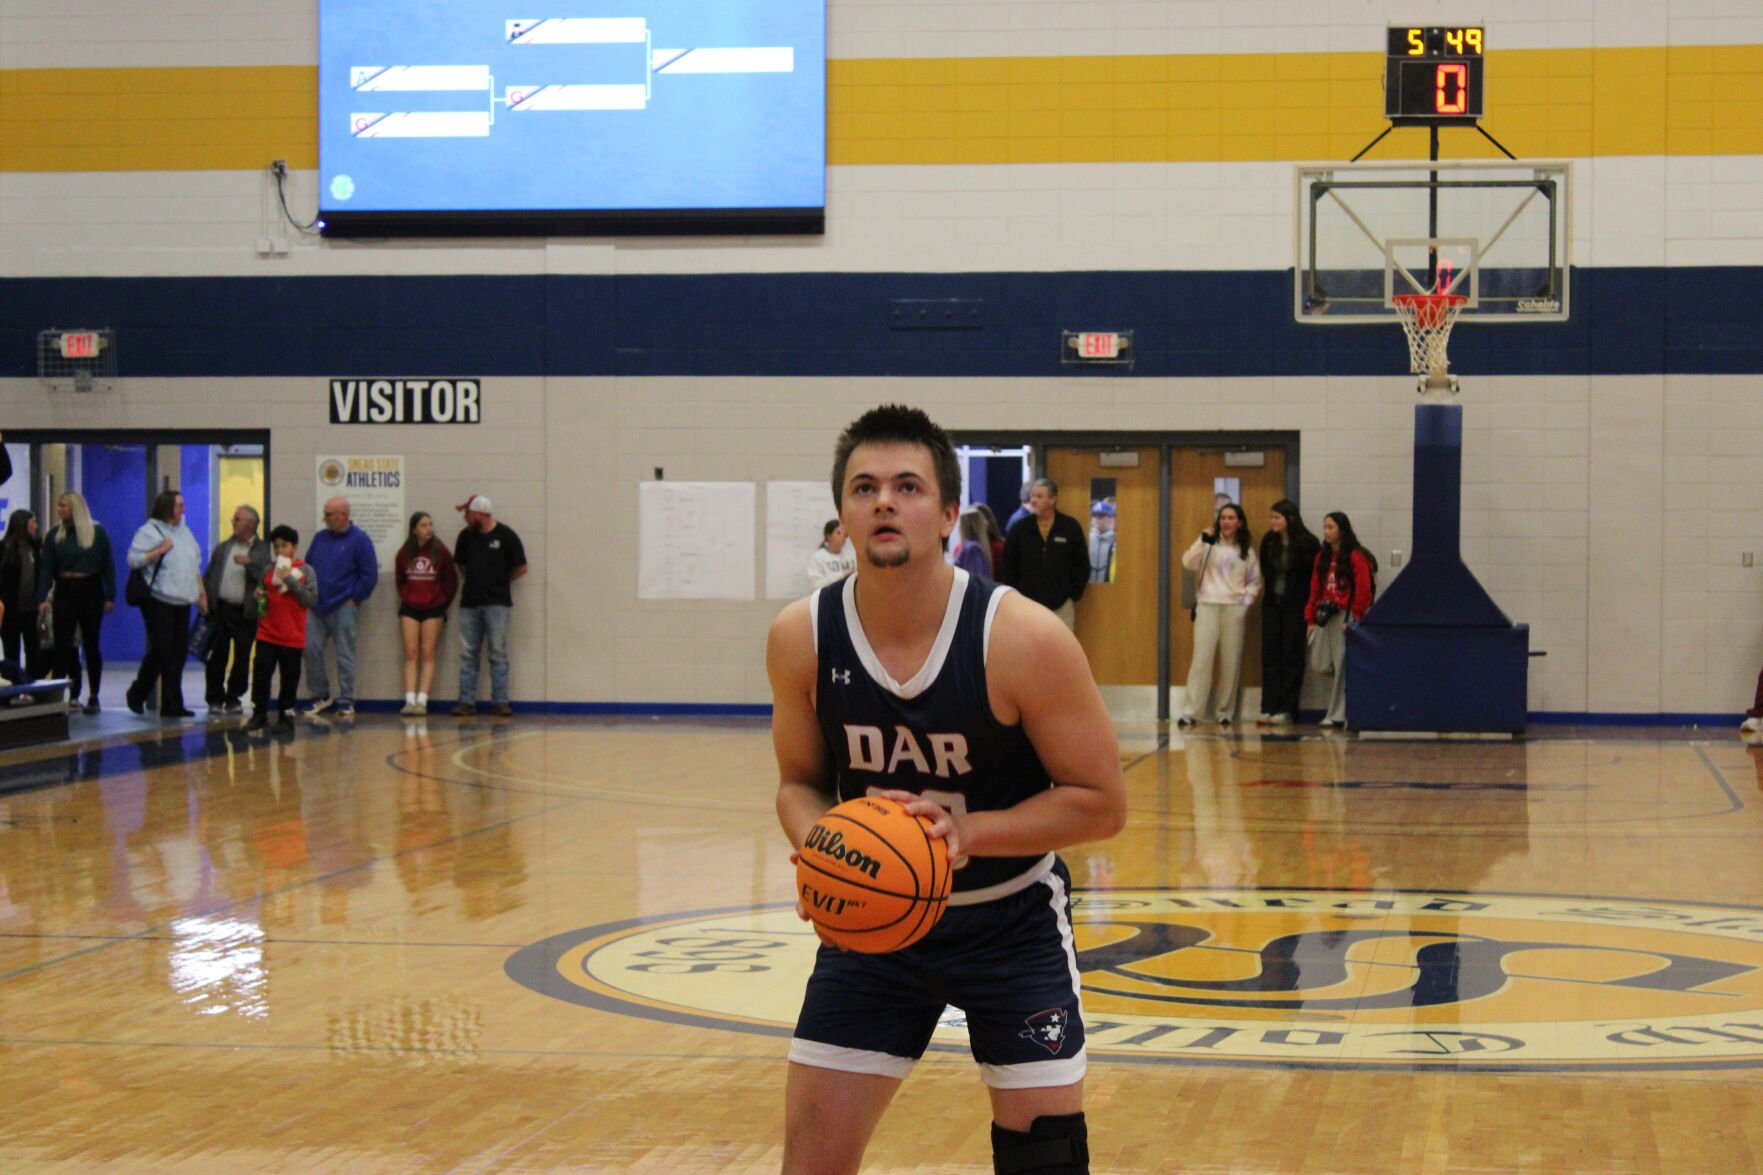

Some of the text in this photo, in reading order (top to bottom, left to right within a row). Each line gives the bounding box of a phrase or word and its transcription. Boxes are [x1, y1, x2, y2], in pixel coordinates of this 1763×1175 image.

[1436, 64, 1466, 113] 0
[67, 335, 93, 356] EXIT
[1086, 334, 1113, 355] EXIT
[332, 380, 479, 422] VISITOR
[346, 471, 401, 488] ATHLETICS
[843, 724, 973, 778] DAR
[804, 824, 882, 880] Wilson
